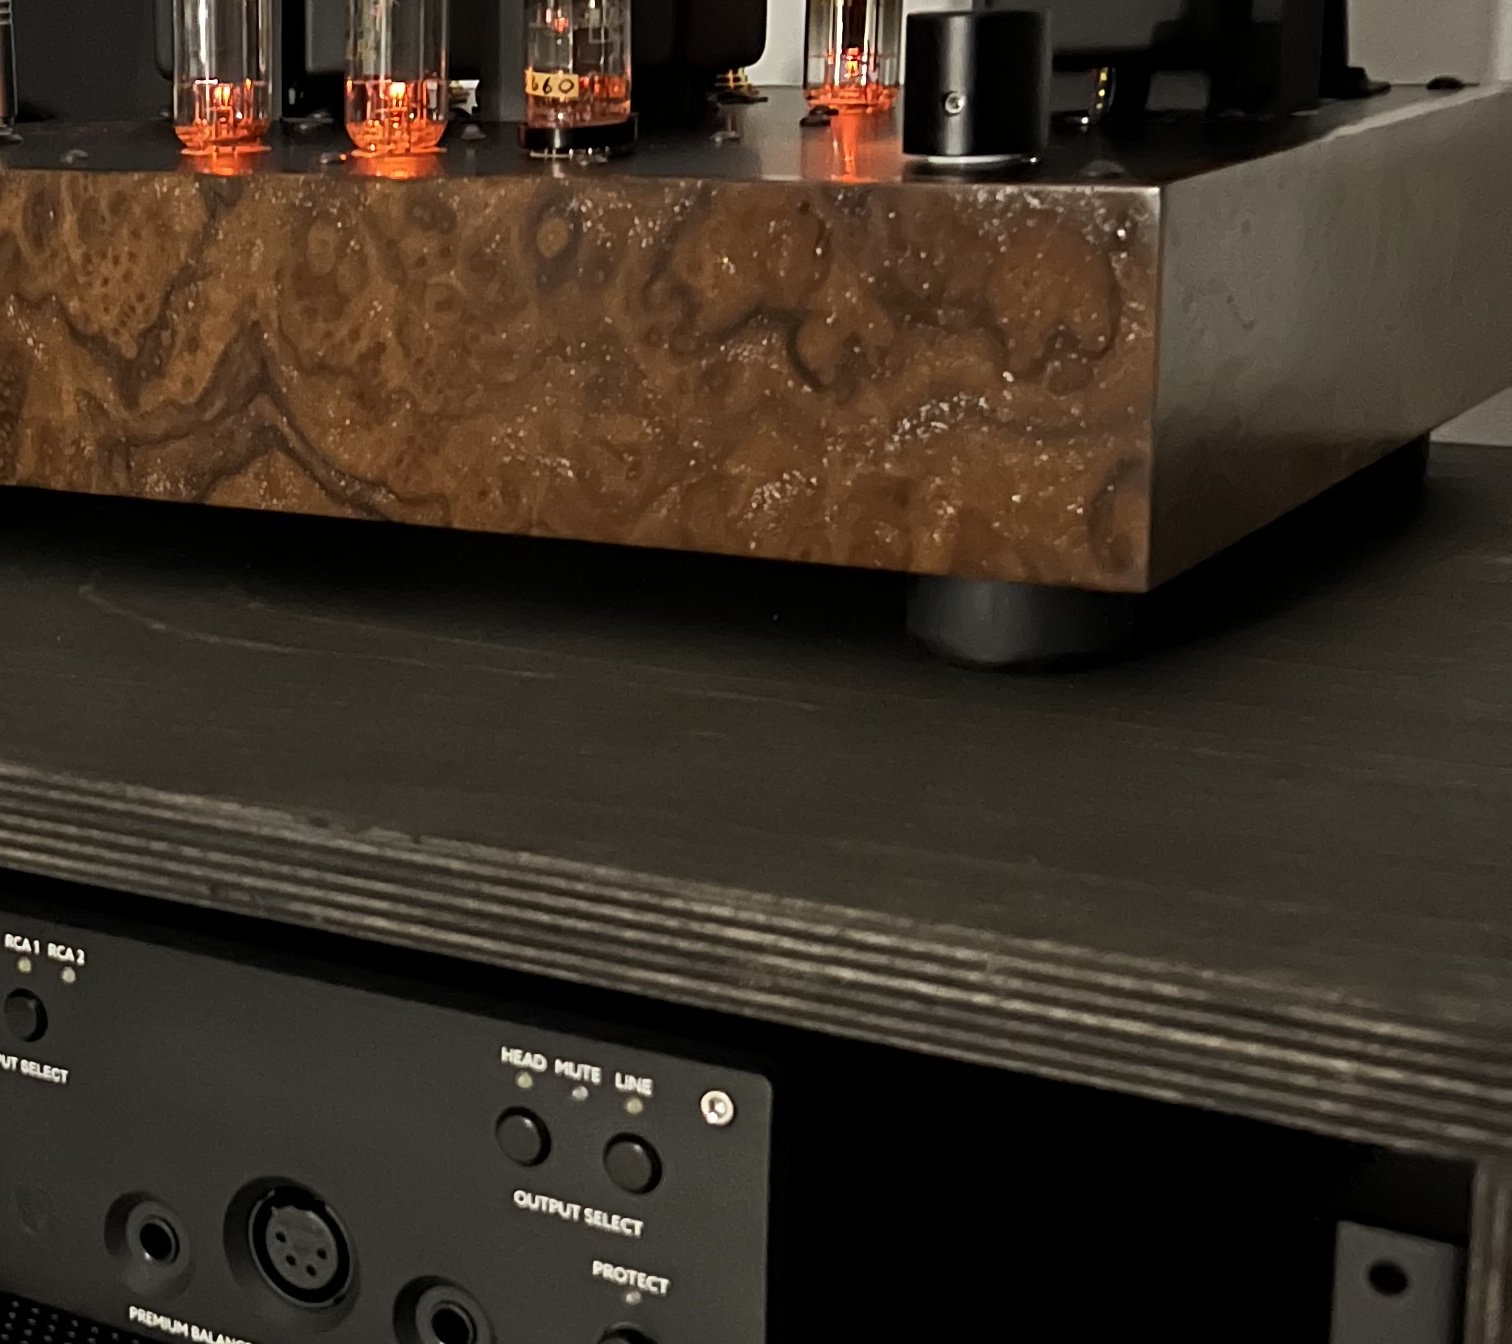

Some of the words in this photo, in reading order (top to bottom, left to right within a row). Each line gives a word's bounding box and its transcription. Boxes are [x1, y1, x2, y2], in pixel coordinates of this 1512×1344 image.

[4, 933, 33, 953] RCA
[47, 942, 75, 962] RCA
[76, 948, 85, 966] 2
[20, 1059, 69, 1084] SELECT
[501, 1046, 548, 1072] HEAD
[554, 1058, 602, 1085] MUTE
[614, 1072, 653, 1097] LINE
[513, 1189, 582, 1221] OUTPUT
[583, 1207, 644, 1237] SELECT
[592, 1260, 670, 1296] PROTECT
[129, 1305, 189, 1338] PREMIUM
